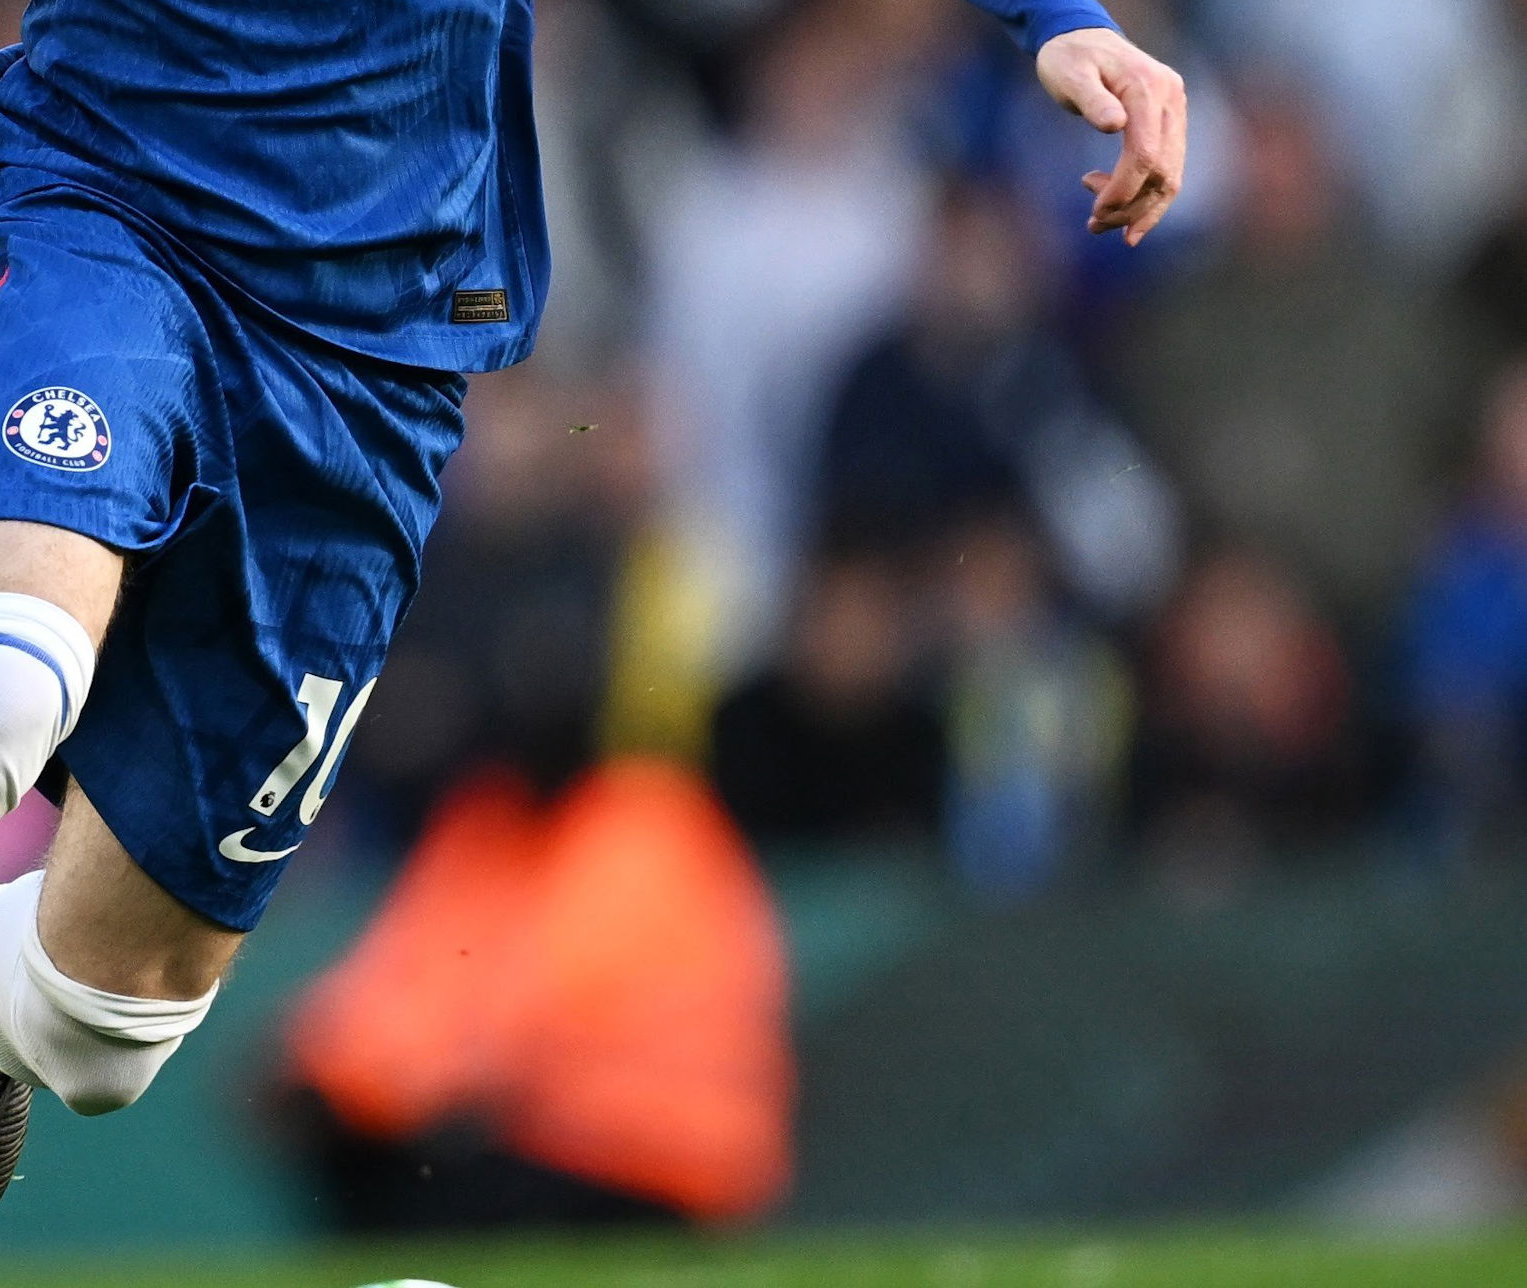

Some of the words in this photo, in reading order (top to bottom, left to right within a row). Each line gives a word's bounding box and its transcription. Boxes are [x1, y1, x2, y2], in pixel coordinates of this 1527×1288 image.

[32, 390, 101, 422] CHELSEA
[15, 442, 58, 464] FOOTBALL
[62, 458, 86, 467] CLUB
